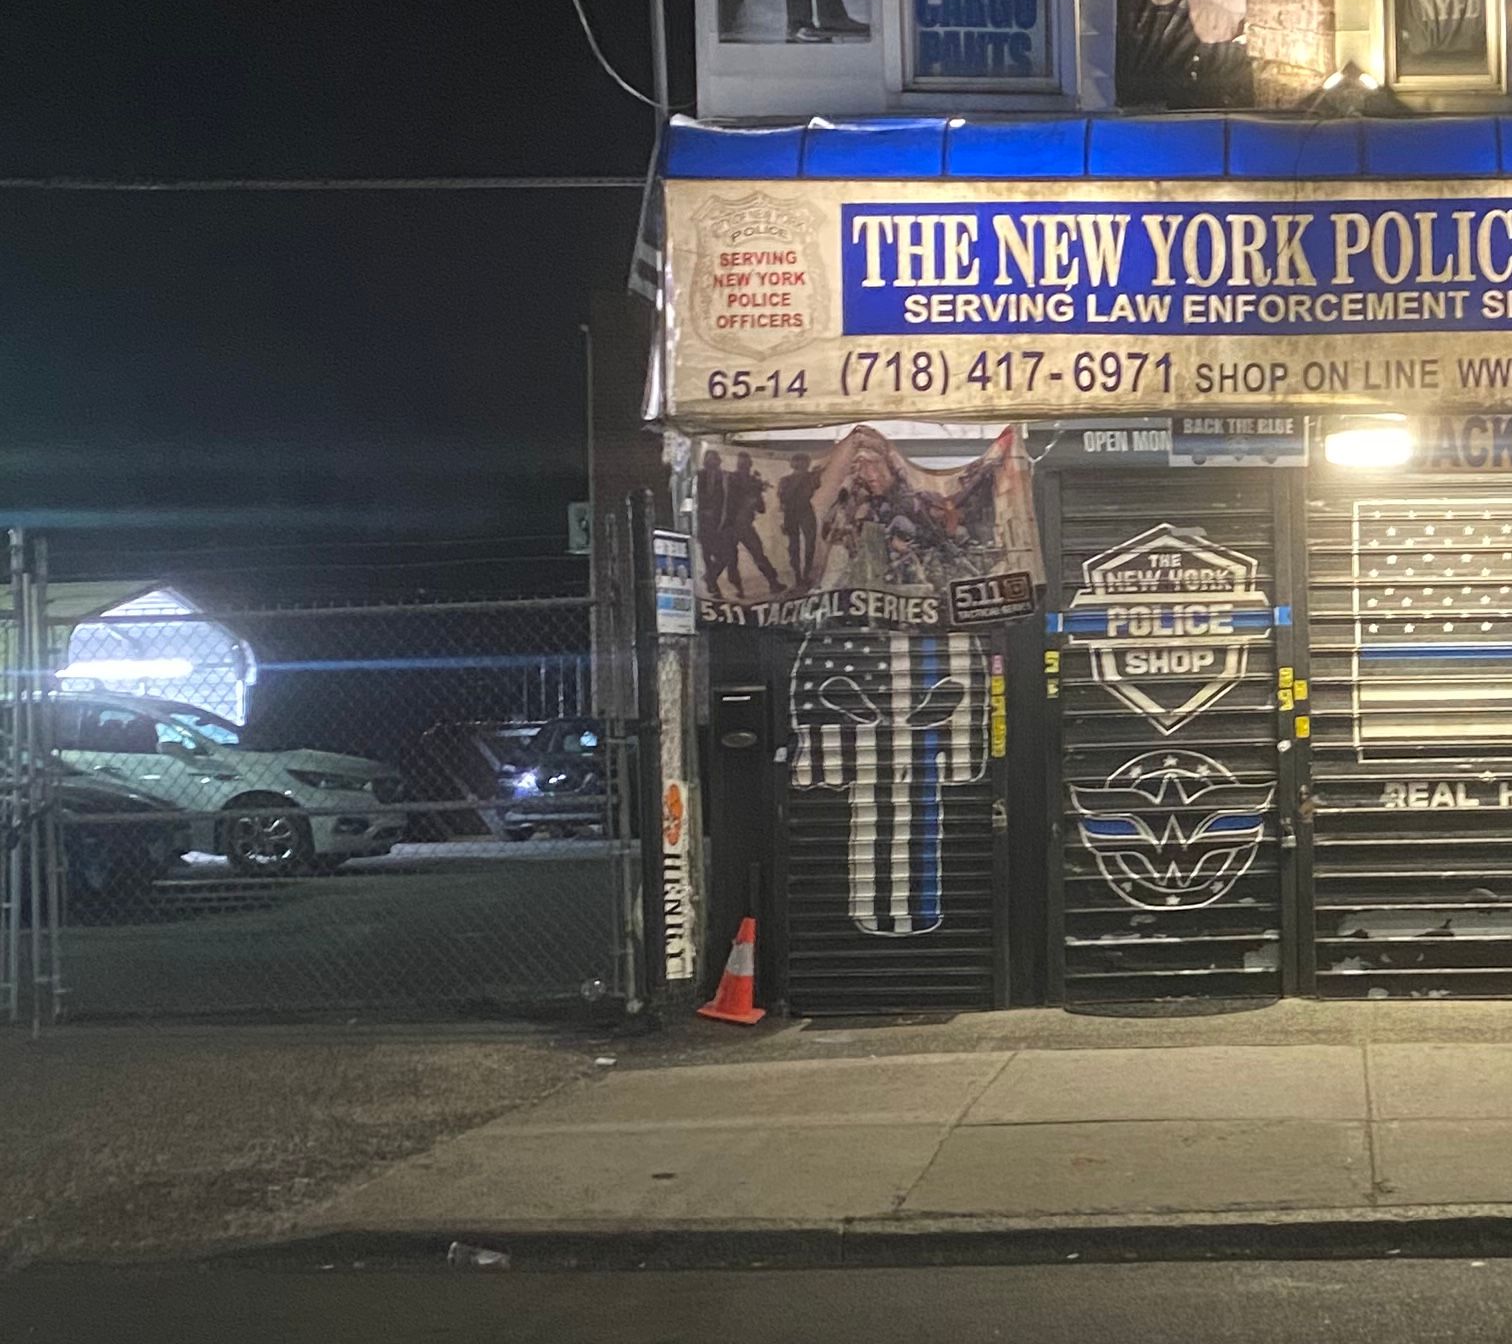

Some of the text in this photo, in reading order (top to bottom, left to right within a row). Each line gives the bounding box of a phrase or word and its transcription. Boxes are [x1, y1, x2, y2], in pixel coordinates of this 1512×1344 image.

[719, 252, 797, 267] SERVING
[851, 213, 981, 288] THE
[992, 213, 1131, 289] NEW
[1141, 210, 1317, 288] YORK
[713, 272, 805, 288] NEW YORK
[727, 293, 791, 307] POLICE
[903, 292, 1073, 323] SERVING
[1086, 293, 1171, 322] LAW
[1182, 290, 1470, 323] ENFORCEMENT
[716, 313, 803, 329] OFFICERS
[708, 370, 807, 400] 65-14
[840, 352, 949, 395] (718)
[1195, 360, 1288, 394] SHOP
[1302, 359, 1349, 391] ON
[1362, 357, 1439, 389] LINE
[1182, 418, 1292, 434] BACK THE BLUE
[1083, 431, 1127, 452] OPEN
[1148, 554, 1181, 567] THE
[1106, 569, 1232, 592] NEW YORK
[956, 581, 1004, 607] 5.11
[700, 601, 745, 625] 5.11
[750, 591, 845, 627] TACTICAL
[848, 590, 939, 624] SERIES
[1107, 604, 1234, 637] POLICE
[1125, 650, 1215, 674] SHOP
[1380, 782, 1479, 807] REAL
